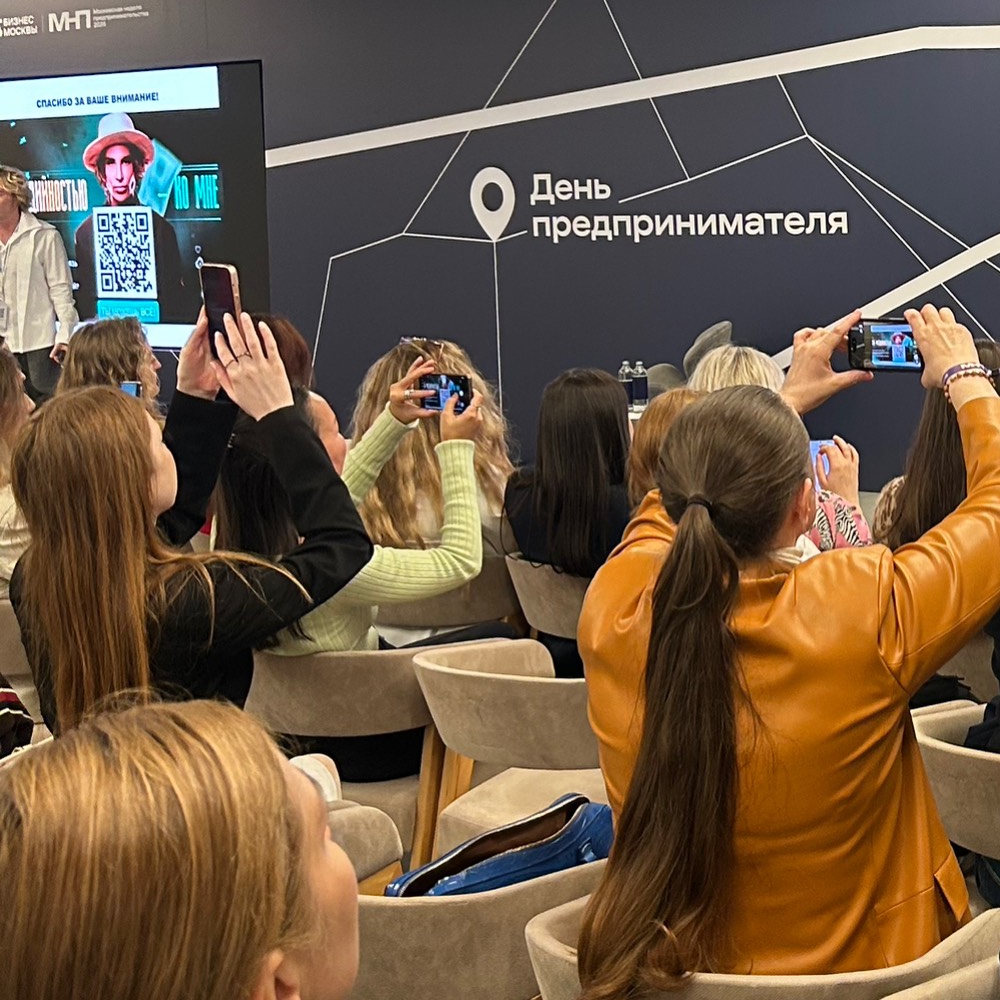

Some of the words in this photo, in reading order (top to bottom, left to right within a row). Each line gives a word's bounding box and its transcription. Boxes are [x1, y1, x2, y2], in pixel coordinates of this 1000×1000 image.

[3, 15, 35, 27] БИЗНЕС
[3, 26, 38, 37] МОСКВЫ
[48, 9, 91, 33] МНП
[36, 97, 73, 108] СПАСИБО
[75, 96, 85, 106] ЗА
[87, 95, 109, 105] ВАШЕ
[111, 92, 159, 103] ВНИМАНИЕ!
[194, 174, 220, 210] МНЕ
[529, 173, 612, 205] День
[531, 210, 849, 243] предпринимателя
